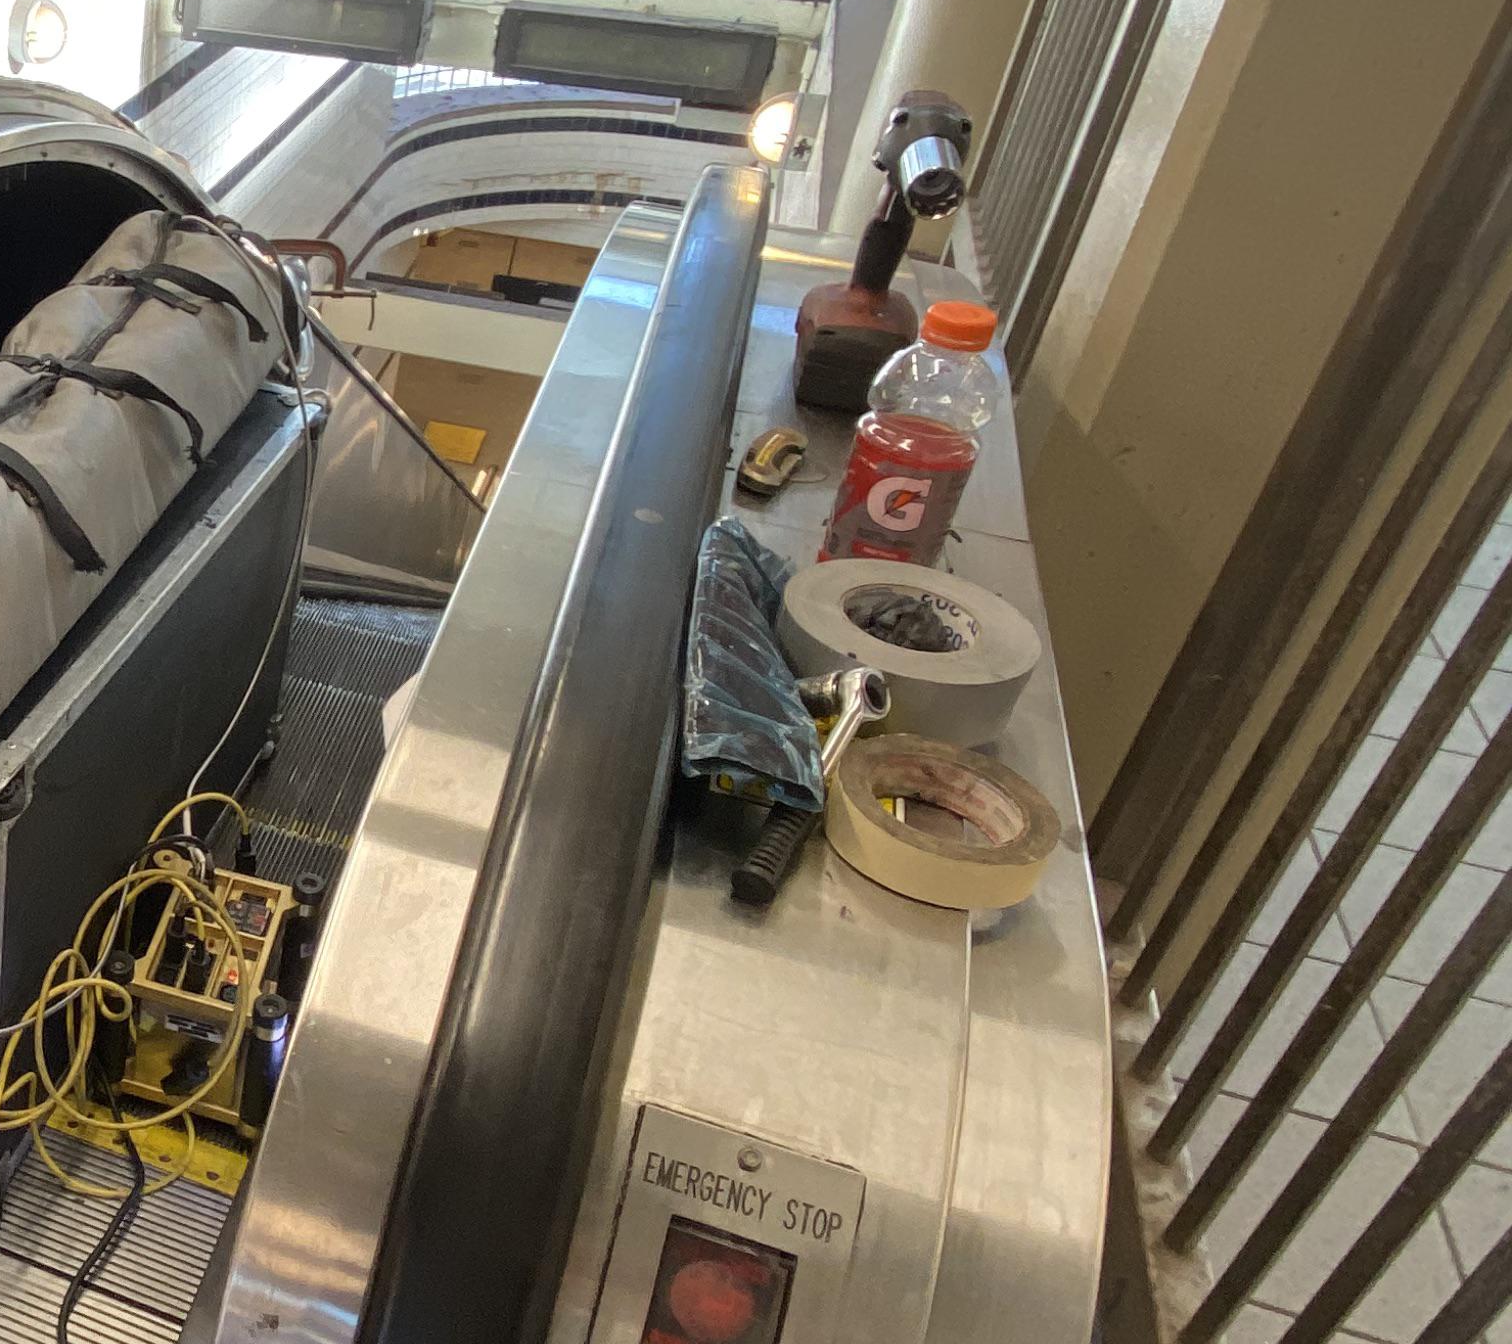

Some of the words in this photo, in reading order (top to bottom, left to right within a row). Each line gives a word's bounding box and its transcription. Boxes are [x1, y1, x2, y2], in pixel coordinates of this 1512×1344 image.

[867, 476, 932, 532] G
[642, 1151, 772, 1220] EMERGENCY
[783, 1198, 843, 1244] STOP
